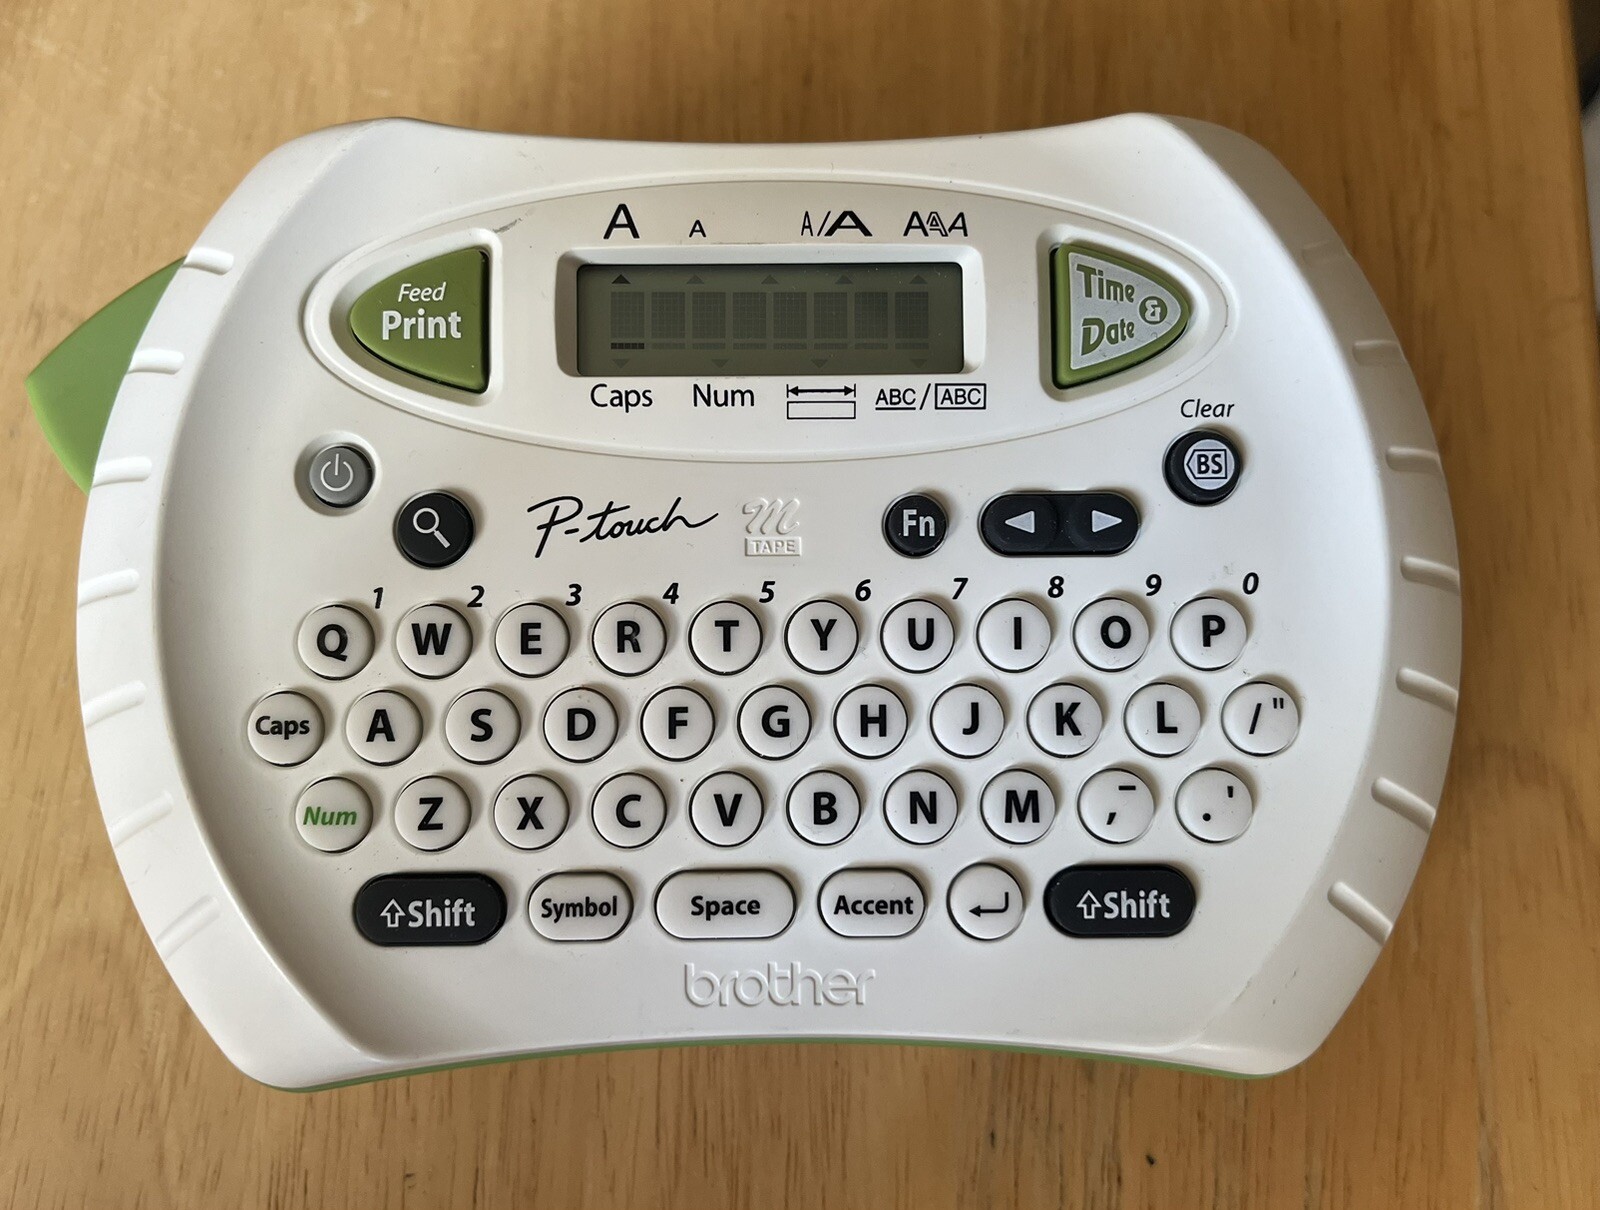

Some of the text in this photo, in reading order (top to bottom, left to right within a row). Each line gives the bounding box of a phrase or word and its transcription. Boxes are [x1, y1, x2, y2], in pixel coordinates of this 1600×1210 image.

[604, 204, 639, 239] A
[689, 220, 706, 237] A
[398, 282, 446, 302] Feed
[1076, 264, 1135, 303] Time
[383, 308, 461, 340] Print
[1081, 317, 1135, 356] Date
[591, 384, 652, 413] Caps
[694, 384, 754, 407] Num
[1181, 399, 1234, 417] Clear
[1196, 453, 1223, 475] BS
[527, 496, 718, 558] P-touch
[904, 510, 934, 536] Fn
[751, 539, 796, 554] TAPE
[374, 587, 383, 609] 1
[467, 586, 484, 608] 2
[564, 584, 581, 608] 3
[663, 583, 679, 604] 4
[759, 581, 775, 603] 5
[855, 579, 871, 601] 6
[952, 578, 968, 599] 7
[1048, 576, 1064, 598] 8
[1146, 574, 1161, 596] 9
[1243, 572, 1259, 594] 0
[317, 624, 348, 662] Q
[412, 623, 452, 655] W
[521, 623, 542, 654] E
[617, 620, 641, 653] R
[715, 620, 739, 652] T
[811, 619, 837, 651] Y
[908, 618, 934, 651] U
[1014, 617, 1022, 650] I
[1101, 616, 1131, 649] O
[1202, 615, 1225, 647] P
[256, 716, 310, 740] Caps
[366, 709, 395, 742] A
[471, 709, 493, 742] S
[568, 708, 596, 741] D
[669, 707, 688, 739] F
[762, 705, 790, 738] G
[860, 704, 887, 737] H
[963, 702, 979, 735] J
[1056, 702, 1081, 736] K
[1157, 701, 1178, 733] L
[303, 807, 357, 825] Num
[418, 797, 443, 831] Z
[517, 797, 544, 830] X
[616, 794, 641, 828] C
[714, 794, 742, 826] V
[814, 792, 837, 825] B
[910, 791, 937, 824] N
[1005, 790, 1040, 823] M
[409, 899, 475, 927] Shift
[542, 896, 617, 921] Symbol
[691, 896, 760, 921] Space
[834, 895, 913, 914] Accent
[1104, 890, 1170, 918] Shift
[684, 961, 876, 1007] brother
